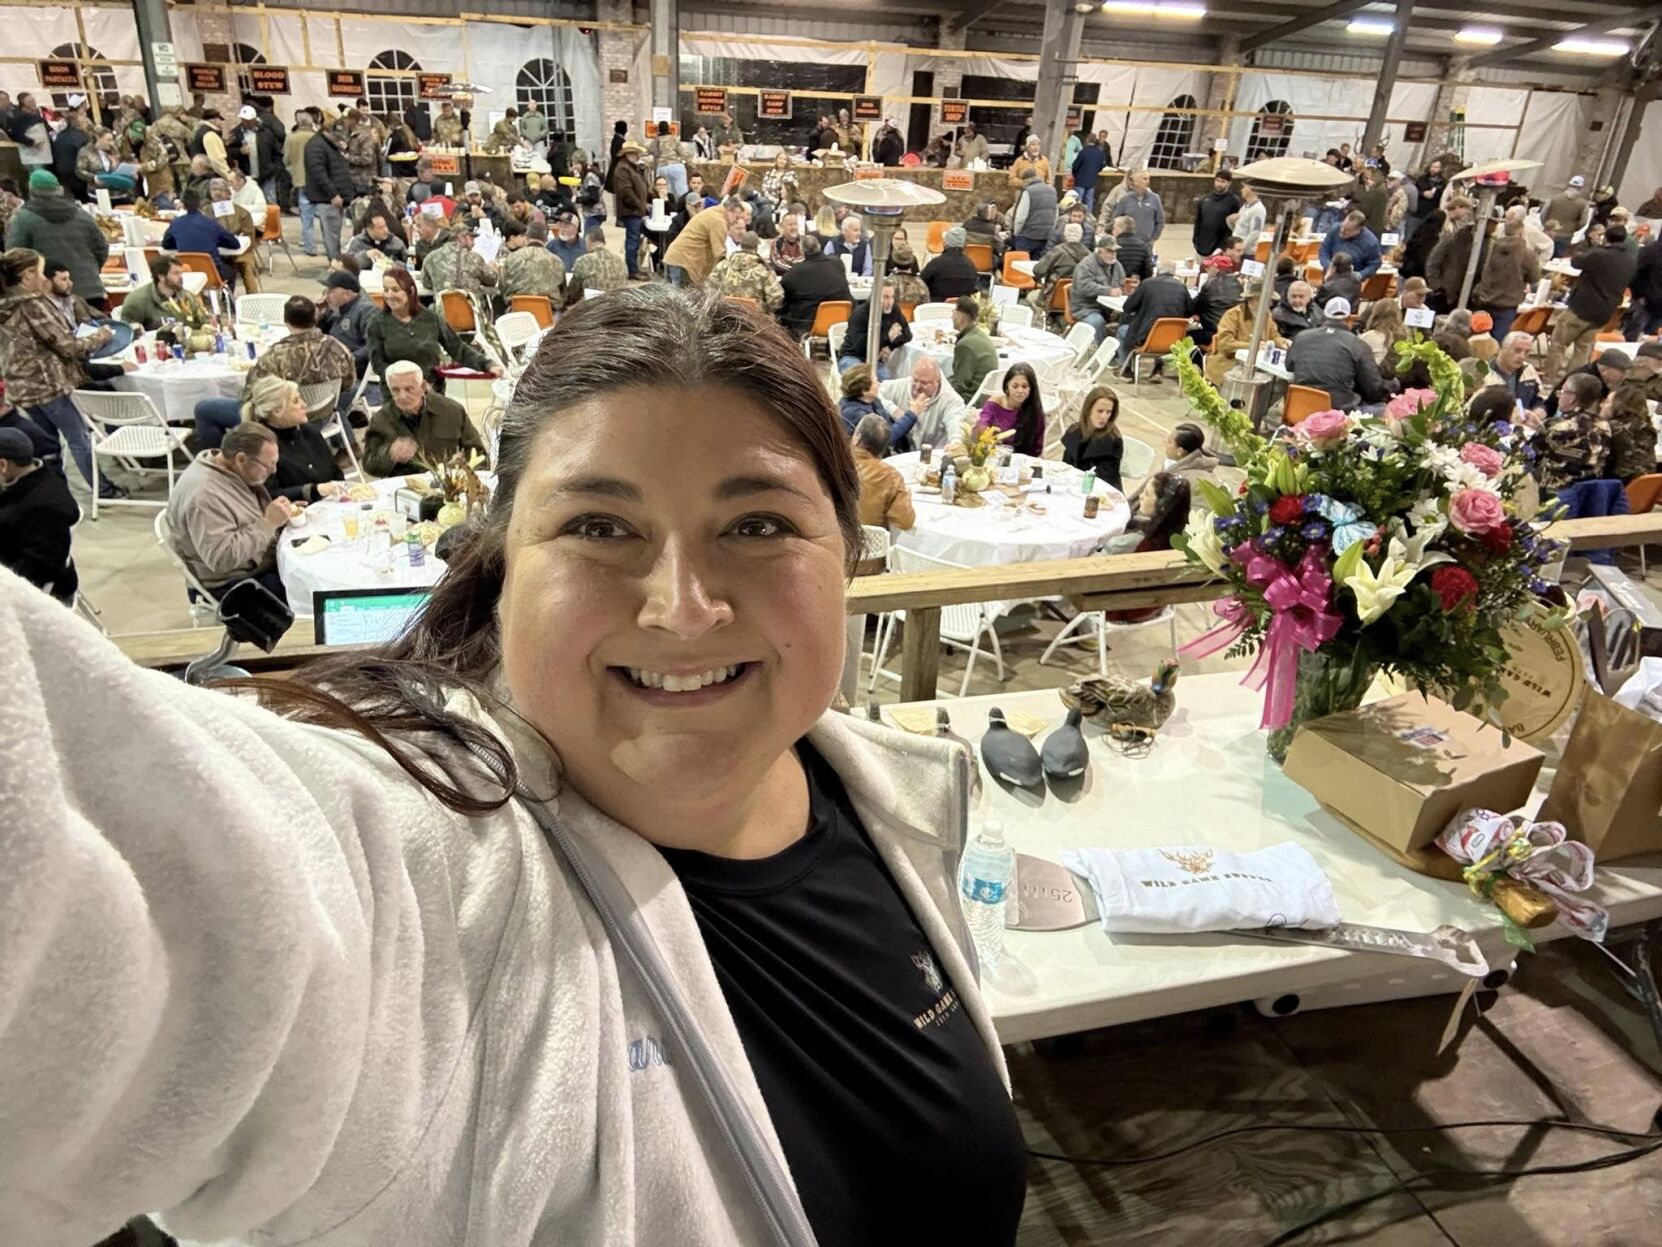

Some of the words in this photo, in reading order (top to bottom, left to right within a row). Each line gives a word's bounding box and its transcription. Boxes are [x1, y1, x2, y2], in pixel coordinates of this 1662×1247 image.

[253, 70, 285, 79] BLOOD
[257, 81, 284, 89] STEW
[1523, 679, 1552, 698] WILD
[1141, 879, 1177, 889] WILD
[913, 1008, 936, 1030] WILD
